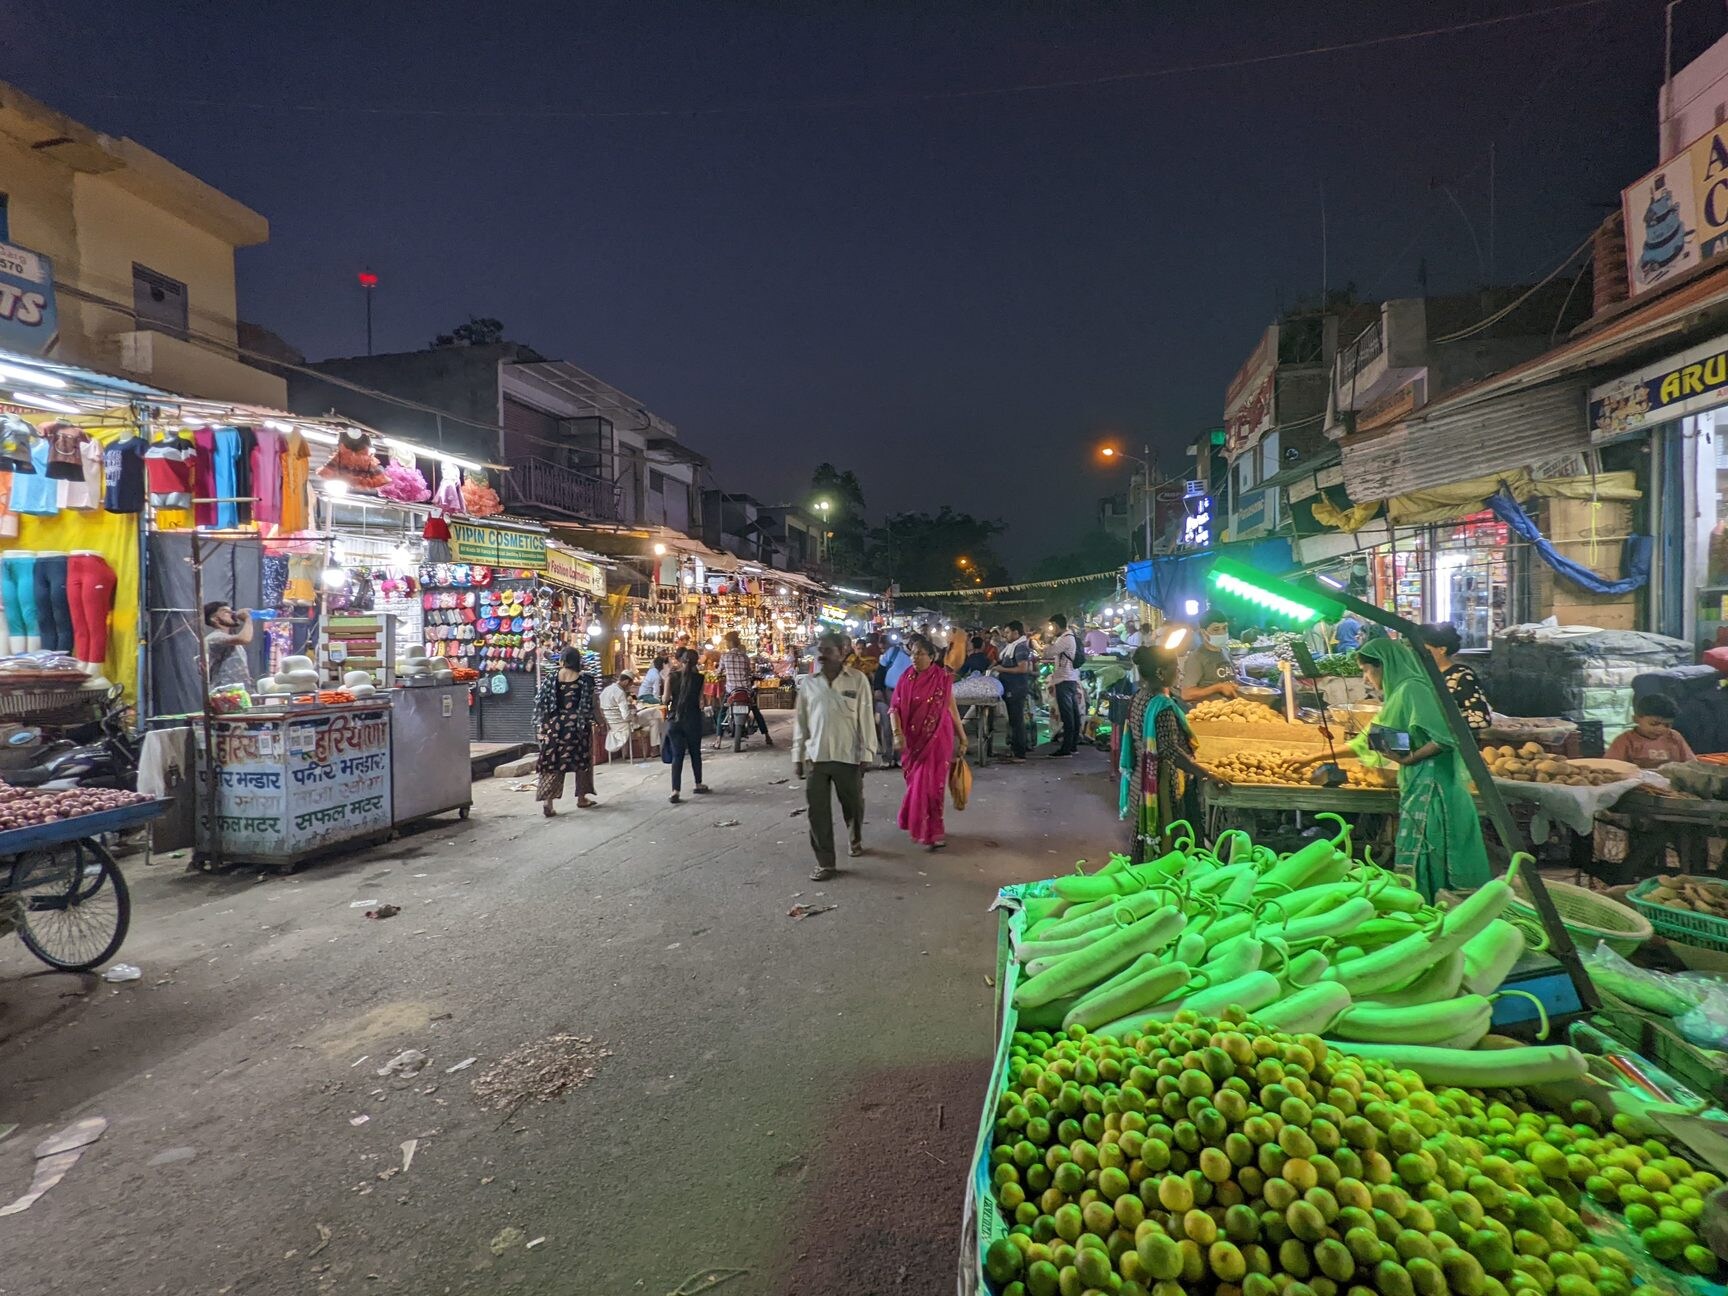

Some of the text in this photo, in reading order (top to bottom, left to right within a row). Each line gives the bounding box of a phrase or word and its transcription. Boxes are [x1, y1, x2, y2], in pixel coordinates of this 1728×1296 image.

[1660, 354, 1727, 404] ARU
[454, 525, 546, 550] VIPIN COSMETICS
[292, 761, 337, 785] पनीर
[294, 794, 384, 831] सफल मटर
